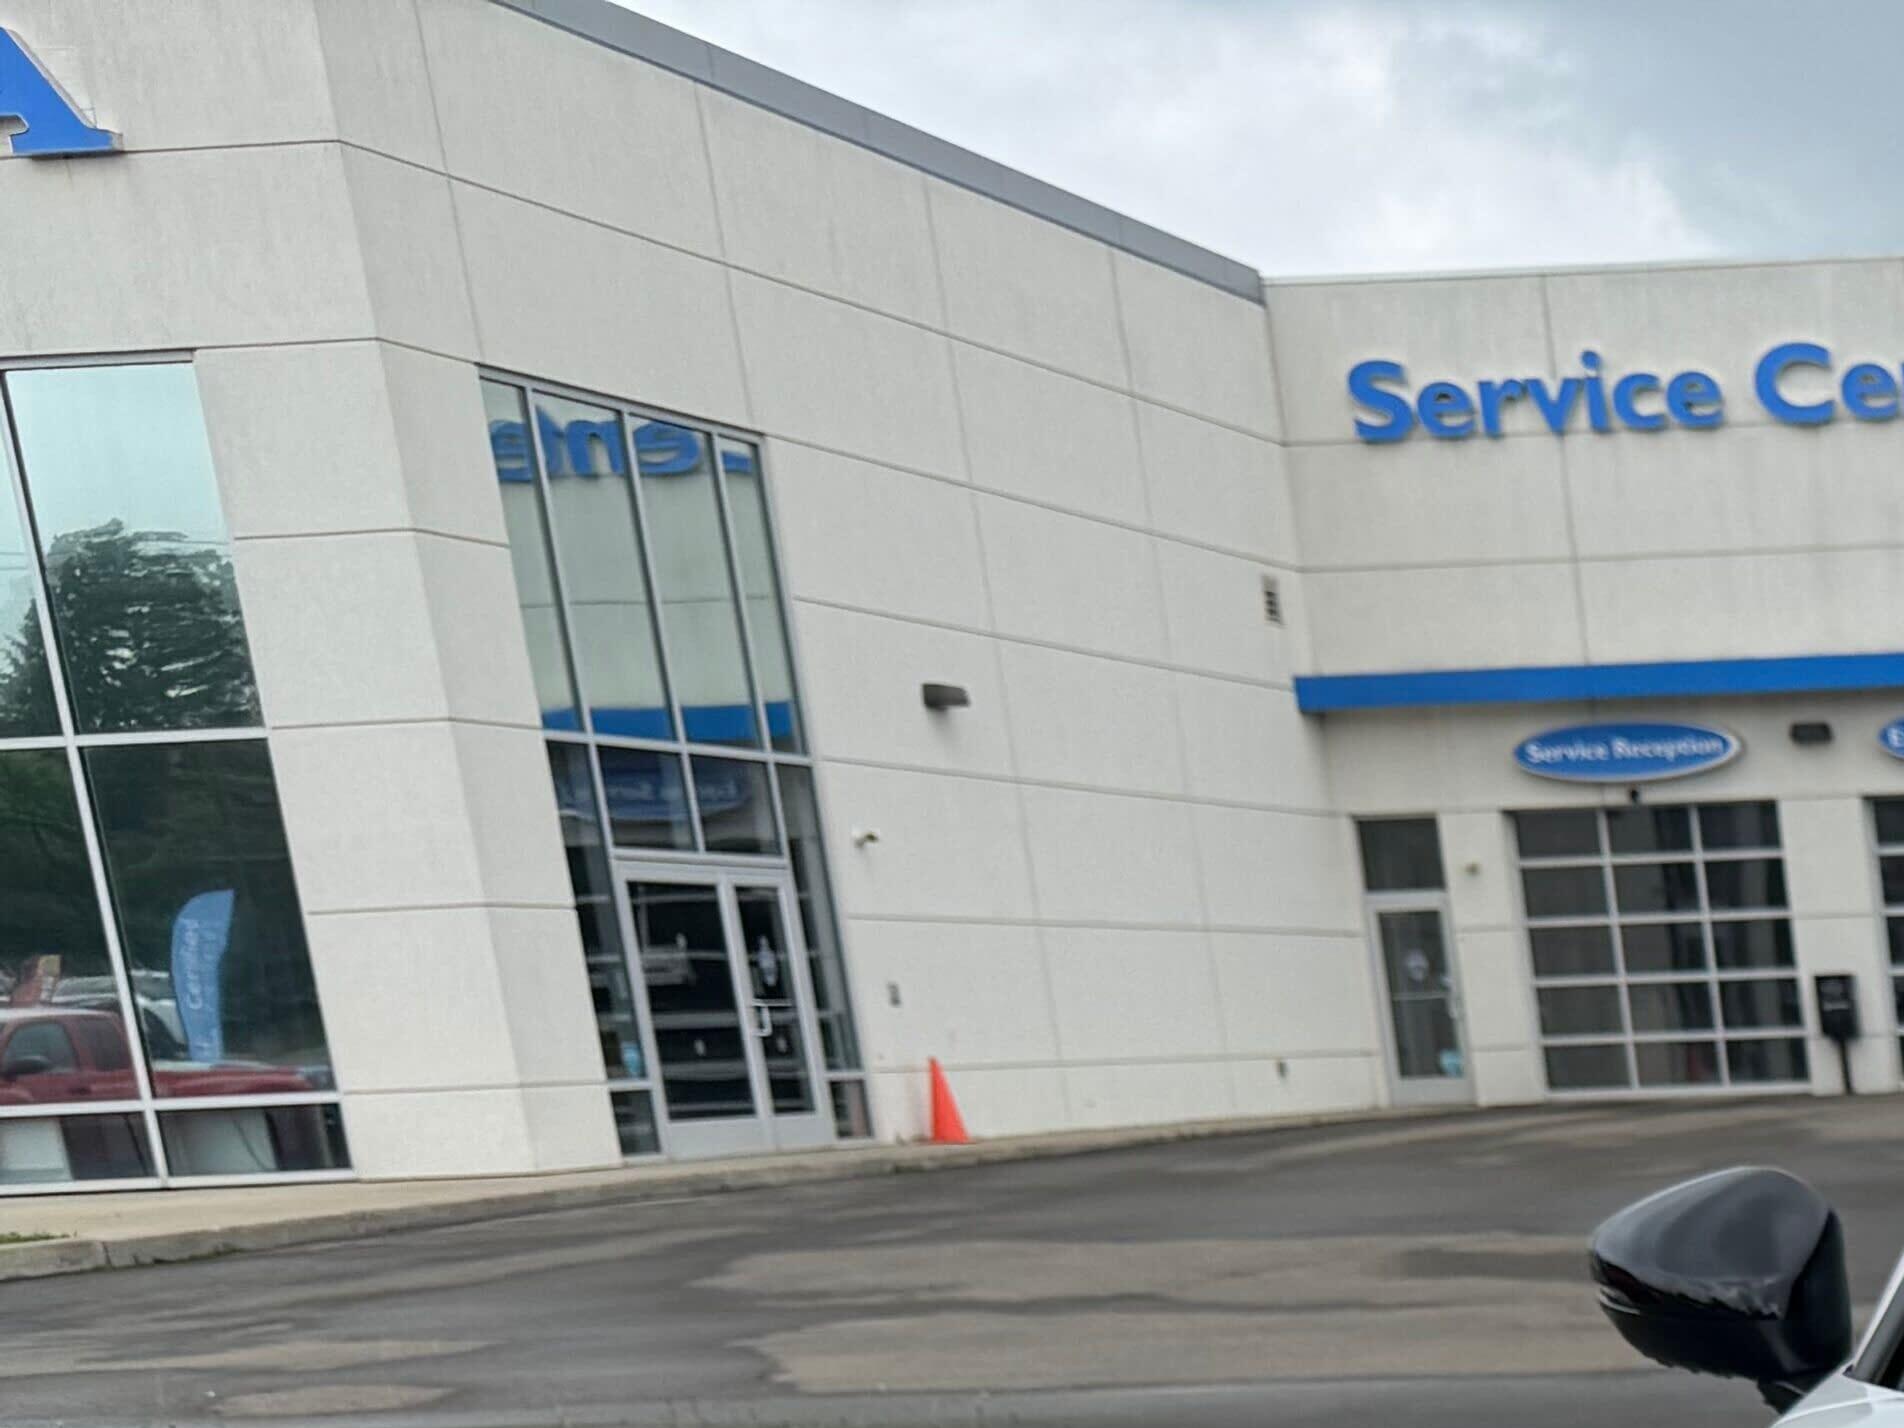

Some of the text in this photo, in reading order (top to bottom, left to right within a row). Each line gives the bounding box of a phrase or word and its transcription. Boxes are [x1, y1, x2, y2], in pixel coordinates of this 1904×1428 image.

[1346, 349, 1725, 444] Service
[1525, 736, 1724, 763] Service Reception
